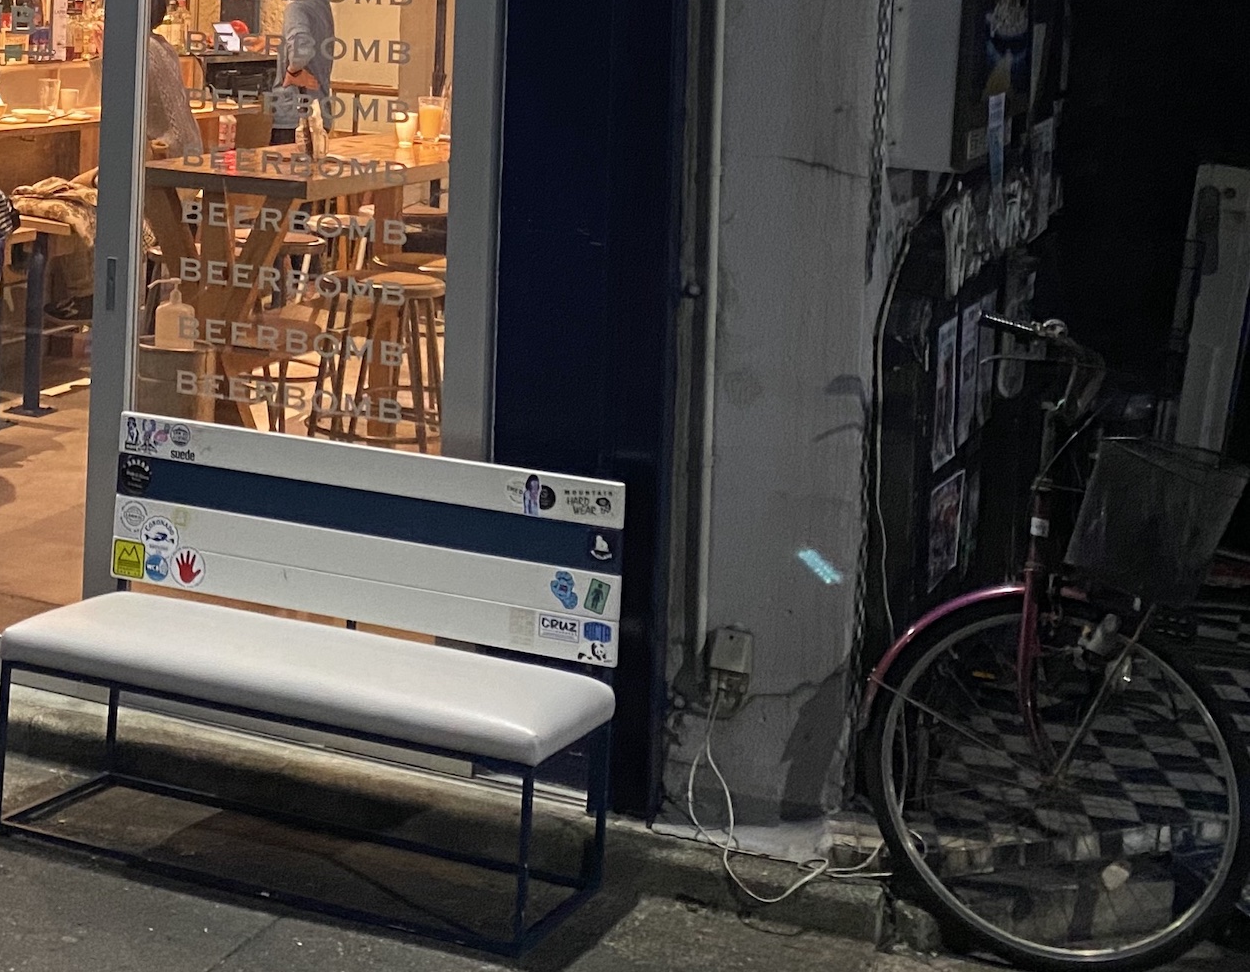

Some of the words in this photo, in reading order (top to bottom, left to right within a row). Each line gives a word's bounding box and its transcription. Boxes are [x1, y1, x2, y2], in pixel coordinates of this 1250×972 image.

[186, 31, 411, 65] BEERBOMB
[185, 86, 410, 123] BEERBOMB
[183, 143, 407, 184] BEERBOMB
[181, 200, 407, 246] BEERBOMB
[179, 257, 405, 306] BEERBOMB
[178, 315, 403, 367] BEERBOMB
[176, 370, 402, 424] BEERBOMB
[171, 449, 195, 461] suede
[564, 489, 613, 497] MOUNTAIN
[567, 497, 590, 506] HARD
[573, 506, 596, 516] WEAR
[541, 617, 578, 632] CRUZ
